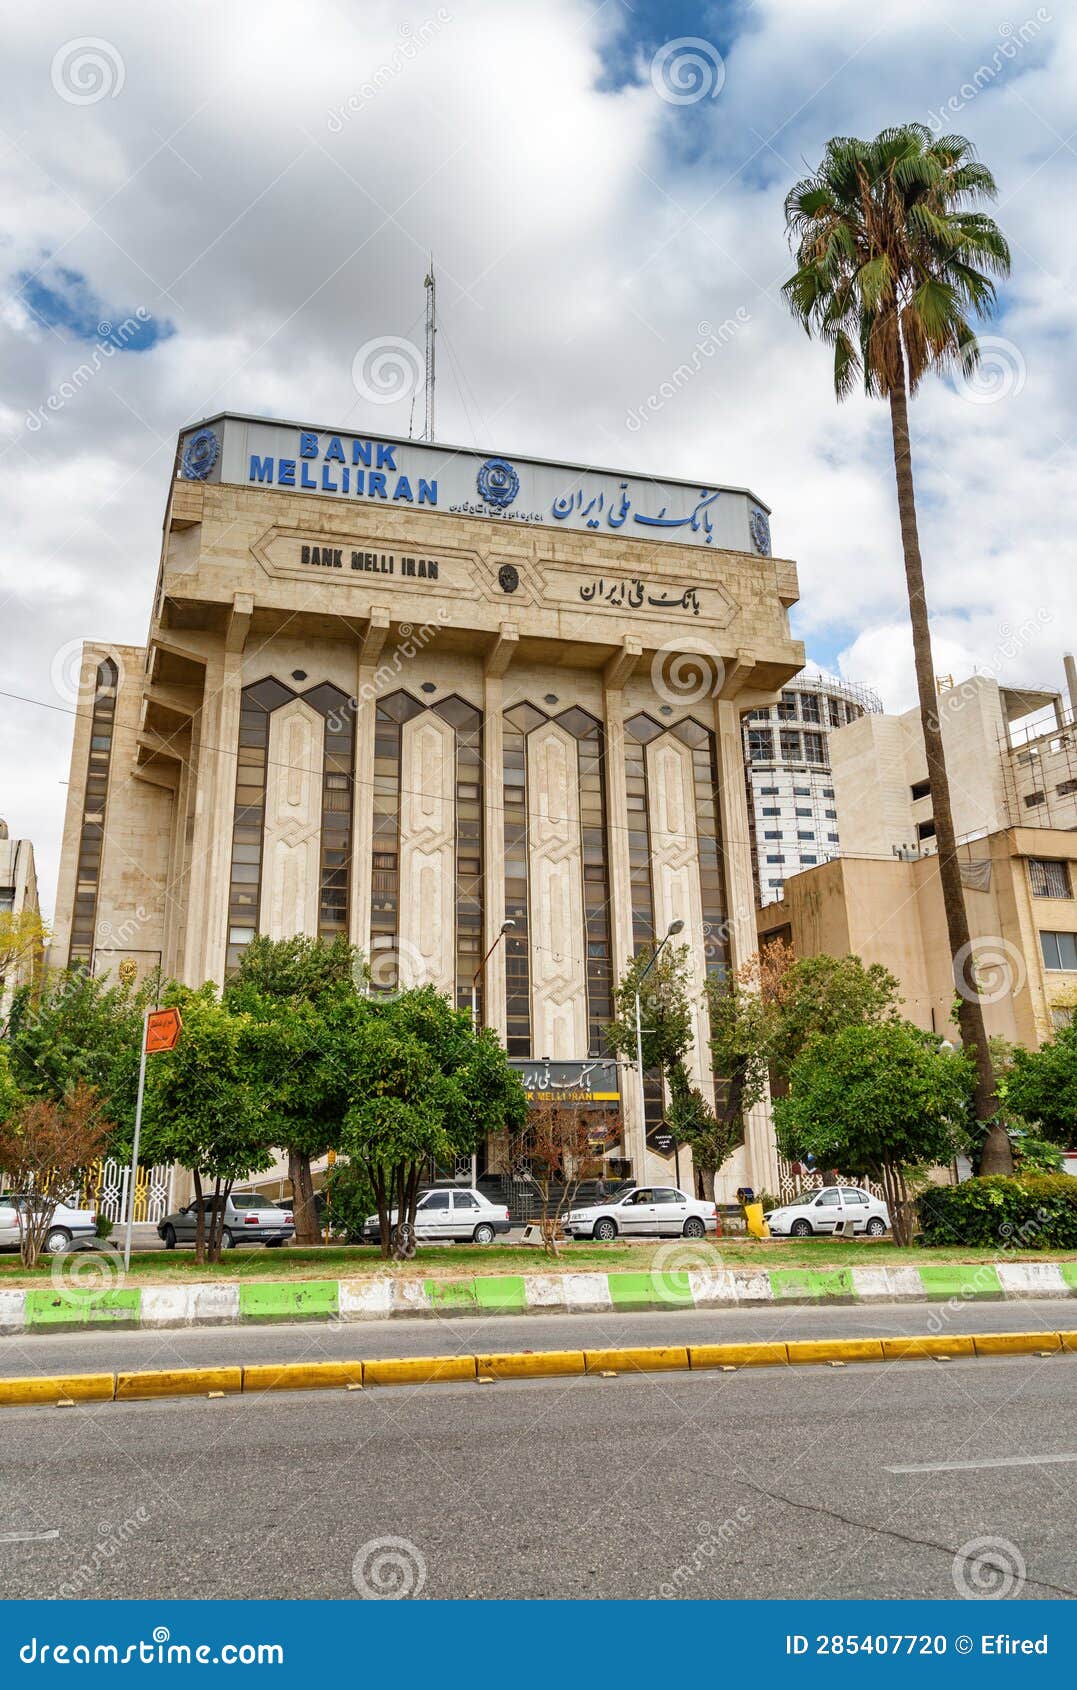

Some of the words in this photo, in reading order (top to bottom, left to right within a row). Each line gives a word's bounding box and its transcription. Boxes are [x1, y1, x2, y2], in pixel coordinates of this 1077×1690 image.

[299, 432, 397, 471] BANK
[552, 489, 604, 529] ایران
[634, 488, 721, 544] بانک
[301, 545, 343, 568] BANK
[351, 551, 395, 574] MELLI
[401, 557, 439, 580] IRAN
[580, 579, 625, 606] ایران
[648, 586, 700, 616] بانک
